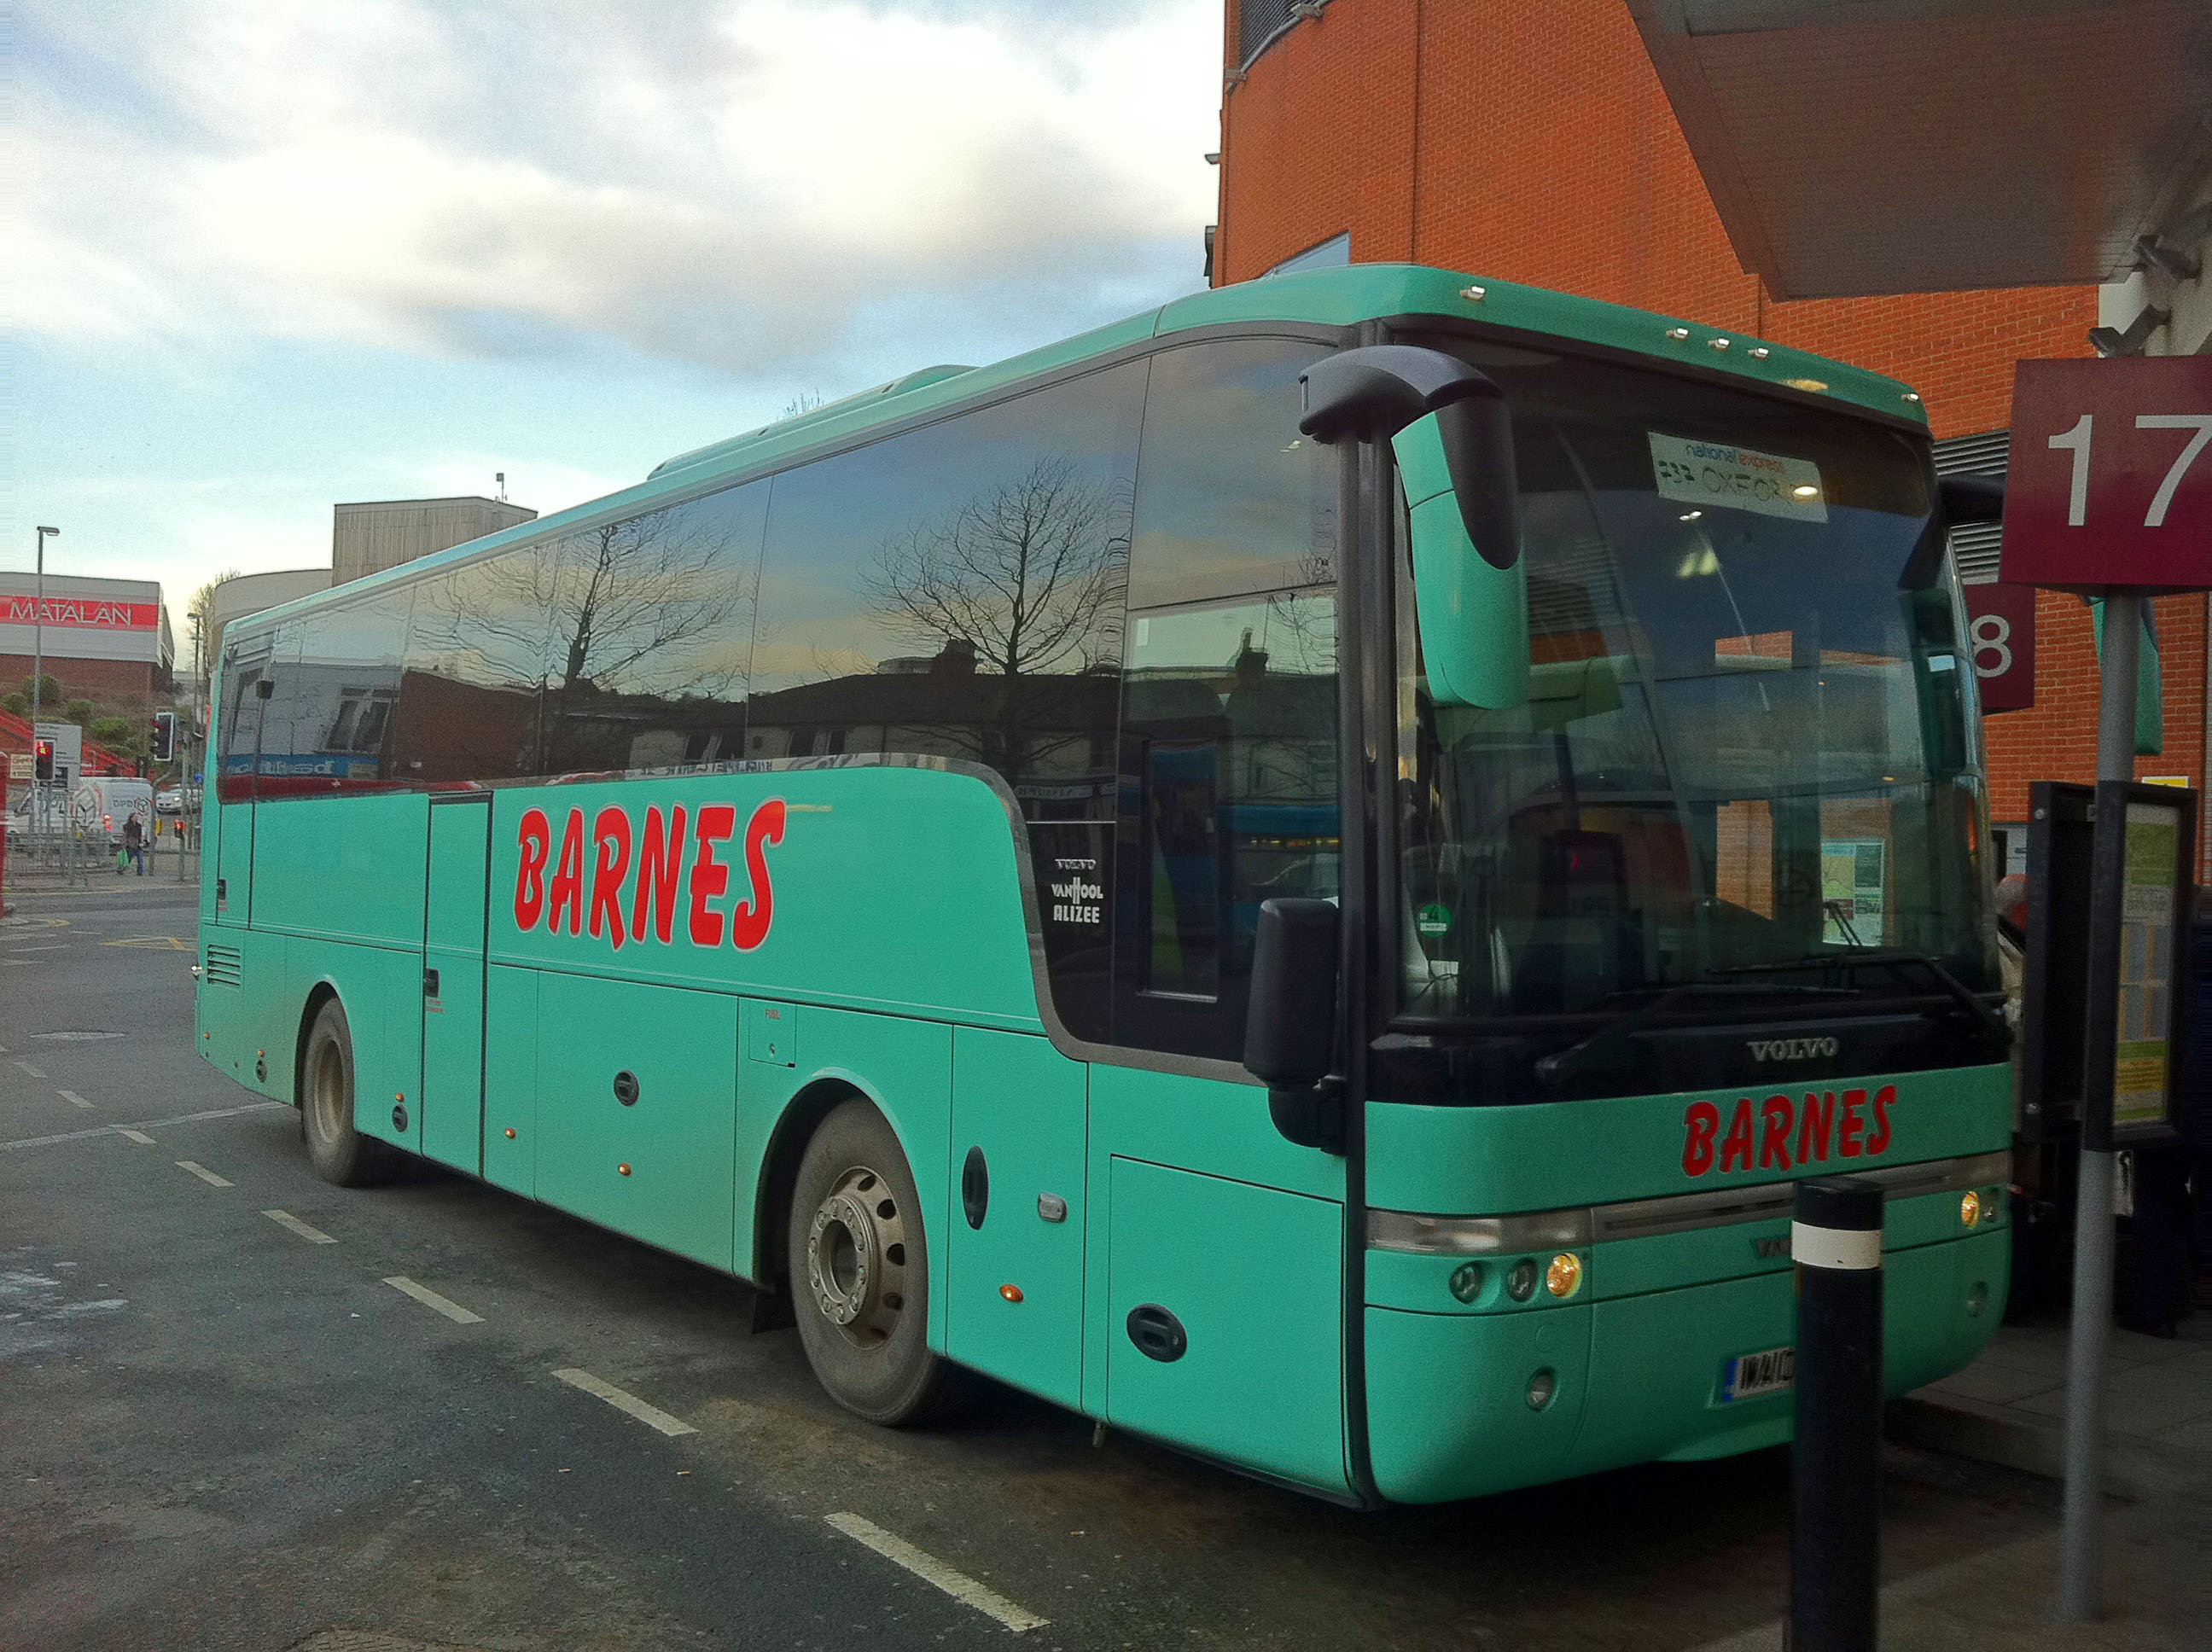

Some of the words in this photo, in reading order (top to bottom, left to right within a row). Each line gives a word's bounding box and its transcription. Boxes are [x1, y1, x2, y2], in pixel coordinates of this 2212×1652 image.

[1686, 444, 1738, 463] national
[1738, 454, 1785, 474] express
[2047, 414, 2212, 527] 17
[1703, 466, 1817, 506] OXFOR
[9, 601, 131, 627] MATALAN
[514, 795, 787, 953] BARNES
[1053, 905, 1100, 923] ALIZEE
[1747, 1036, 1838, 1062] VOLVO
[1681, 1085, 1897, 1178] BARNES
